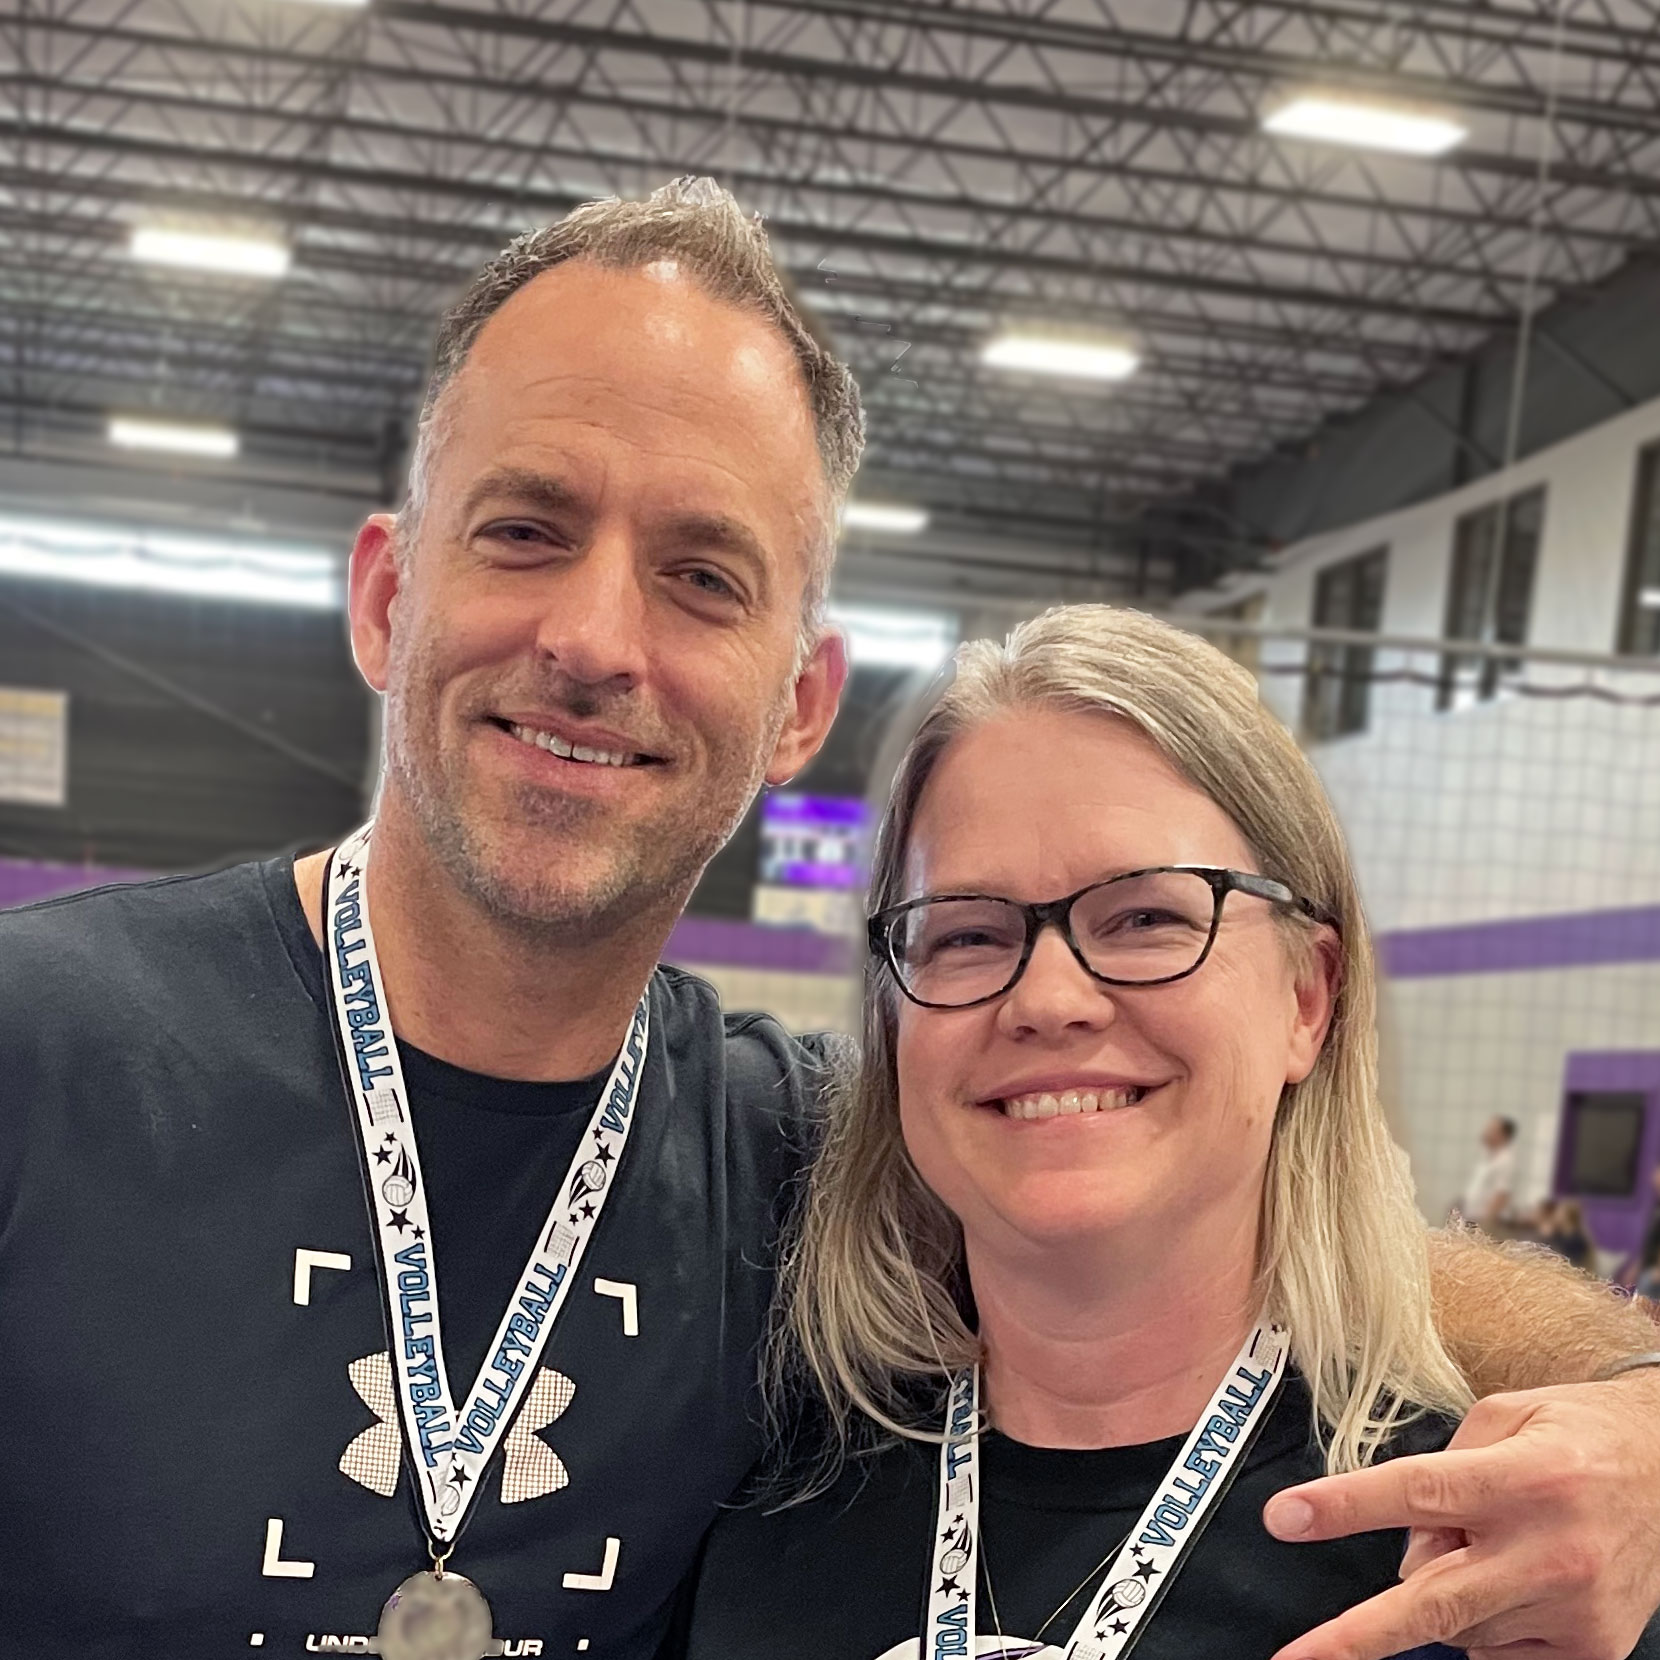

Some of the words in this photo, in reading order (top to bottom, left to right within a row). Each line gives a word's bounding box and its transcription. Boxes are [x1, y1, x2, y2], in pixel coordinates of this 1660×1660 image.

[334, 879, 394, 1091] VOLLEYBALL
[394, 1242, 454, 1468] VOLLEYBALL
[454, 1262, 567, 1455] VOLLEYBALL
[1139, 1366, 1272, 1548] VOLLEYBALL
